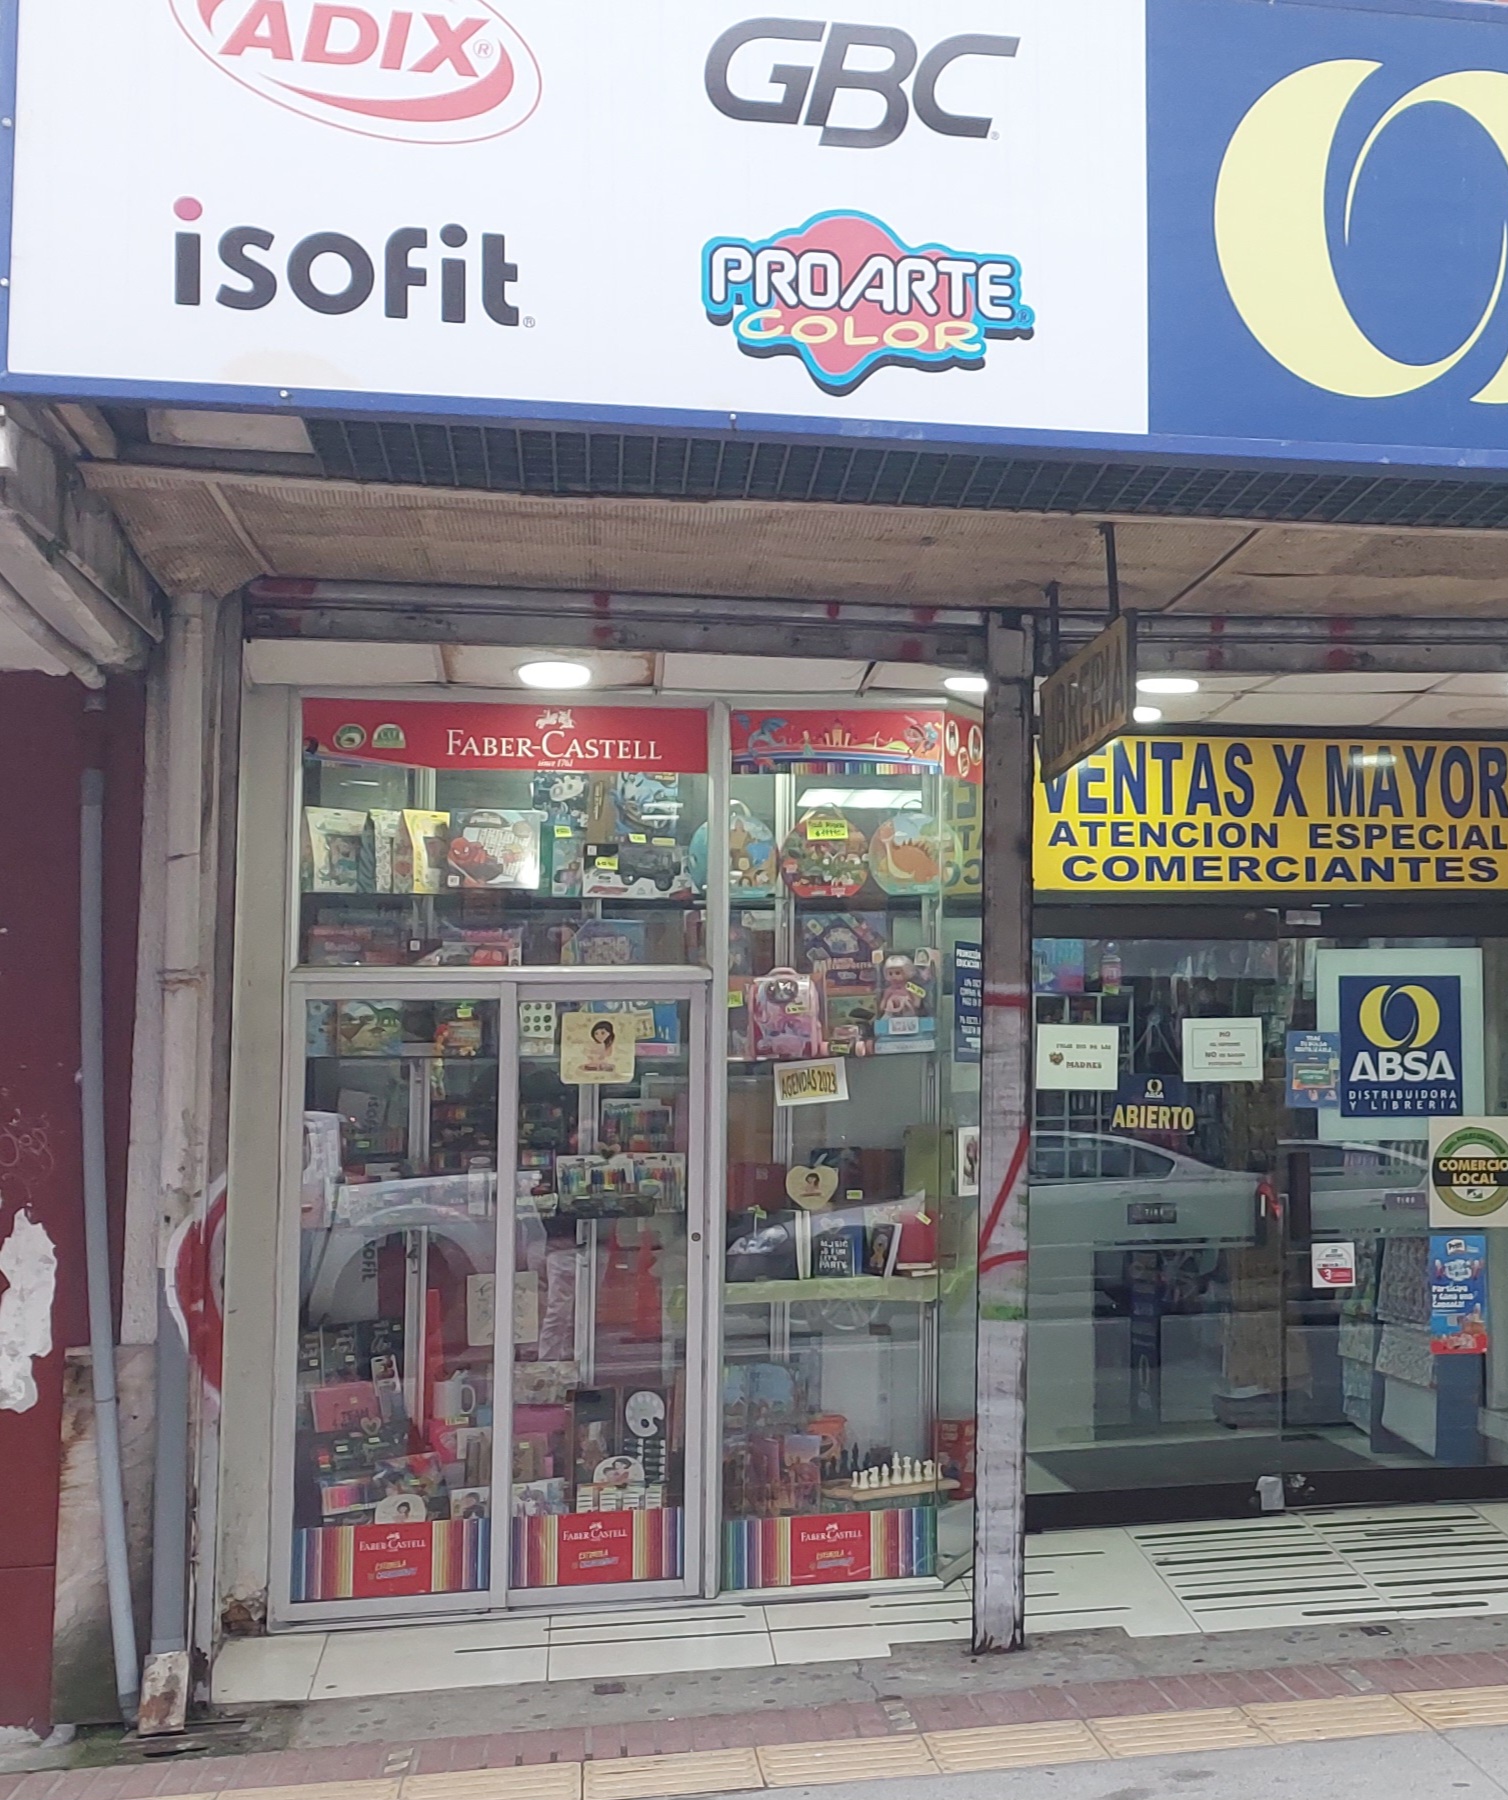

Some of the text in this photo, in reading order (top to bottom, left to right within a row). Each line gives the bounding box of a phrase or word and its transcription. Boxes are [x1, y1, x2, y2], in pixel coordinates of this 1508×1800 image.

[704, 17, 1021, 149] GBC
[173, 196, 520, 327] isofit
[710, 244, 1018, 322] PROARTE
[738, 308, 982, 352] COLOR
[446, 729, 663, 761] FABER-CASTELL
[1043, 740, 1255, 817] VENTAS
[1272, 744, 1308, 817] X
[1048, 821, 1508, 850] ATENCION ESPECIAL
[1062, 855, 1499, 883] COMERCIANTES
[1349, 1051, 1456, 1082] ABSA
[781, 1069, 817, 1100] AGENDAS
[1349, 1089, 1457, 1100] DISTRIBUIDORA
[1112, 1104, 1194, 1130] ABIERTO
[1349, 1100, 1458, 1110] Y LIBRERIA
[1452, 1173, 1498, 1184] LOCAL
